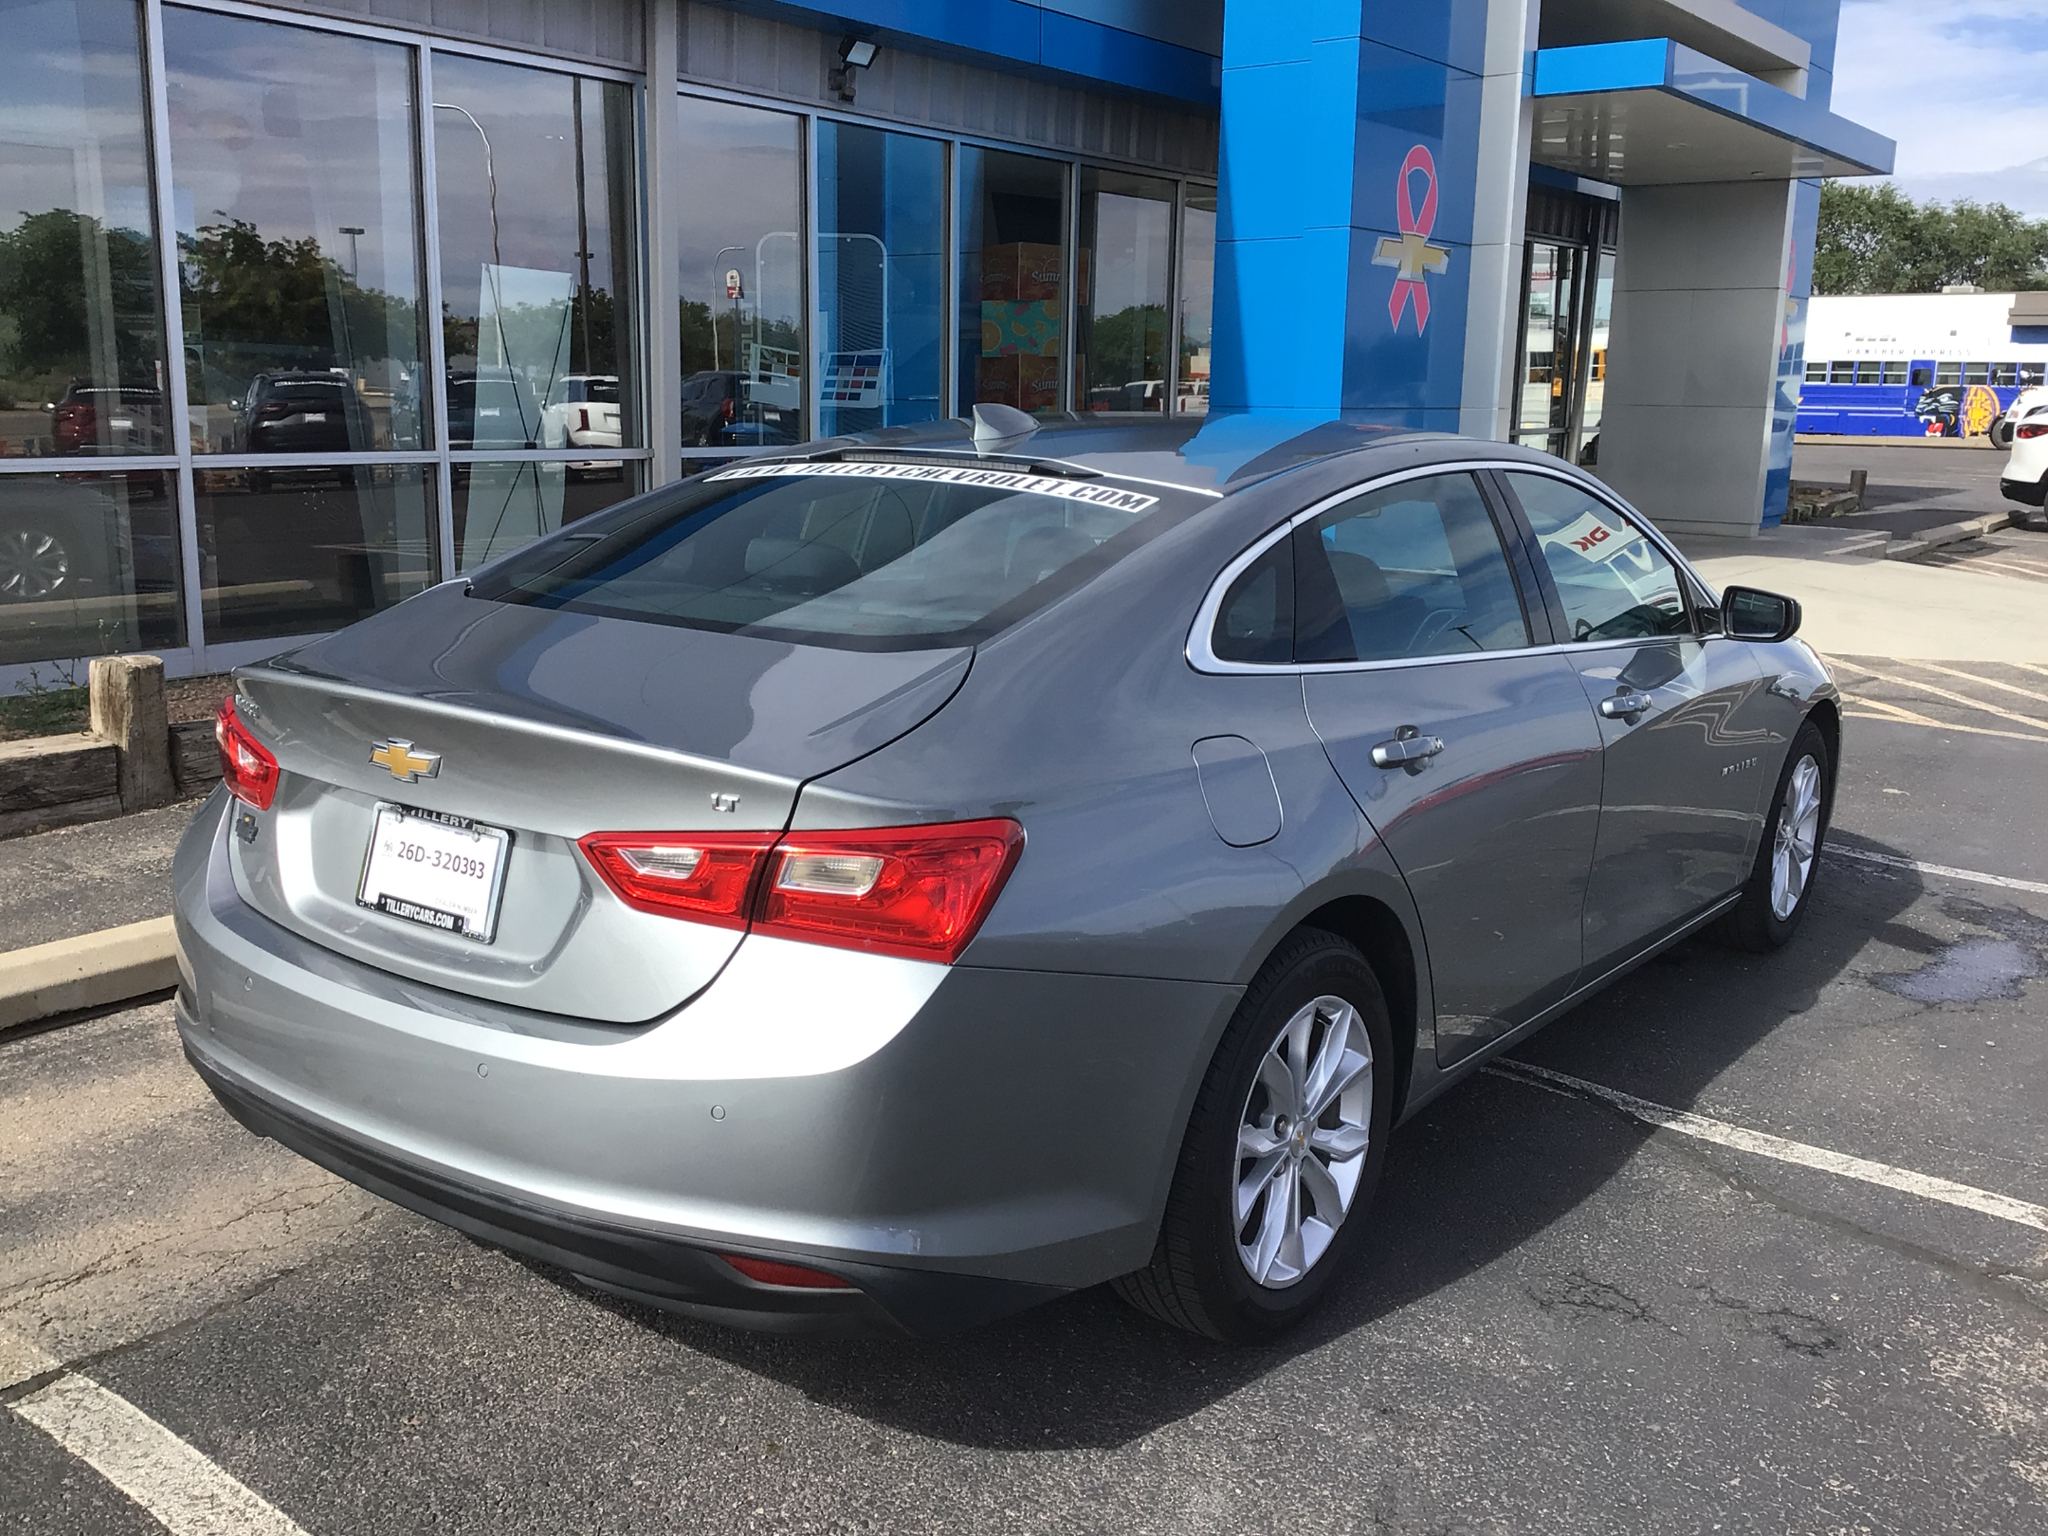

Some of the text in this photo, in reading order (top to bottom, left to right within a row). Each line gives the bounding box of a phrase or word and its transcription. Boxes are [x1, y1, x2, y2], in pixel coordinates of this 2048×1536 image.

[740, 300, 755, 429] CHEROLET
[1721, 757, 1758, 777] MALIBU
[710, 792, 741, 813] LT
[397, 841, 485, 880] 26D-320393
[385, 898, 454, 929] TILLERYCARS.COM
